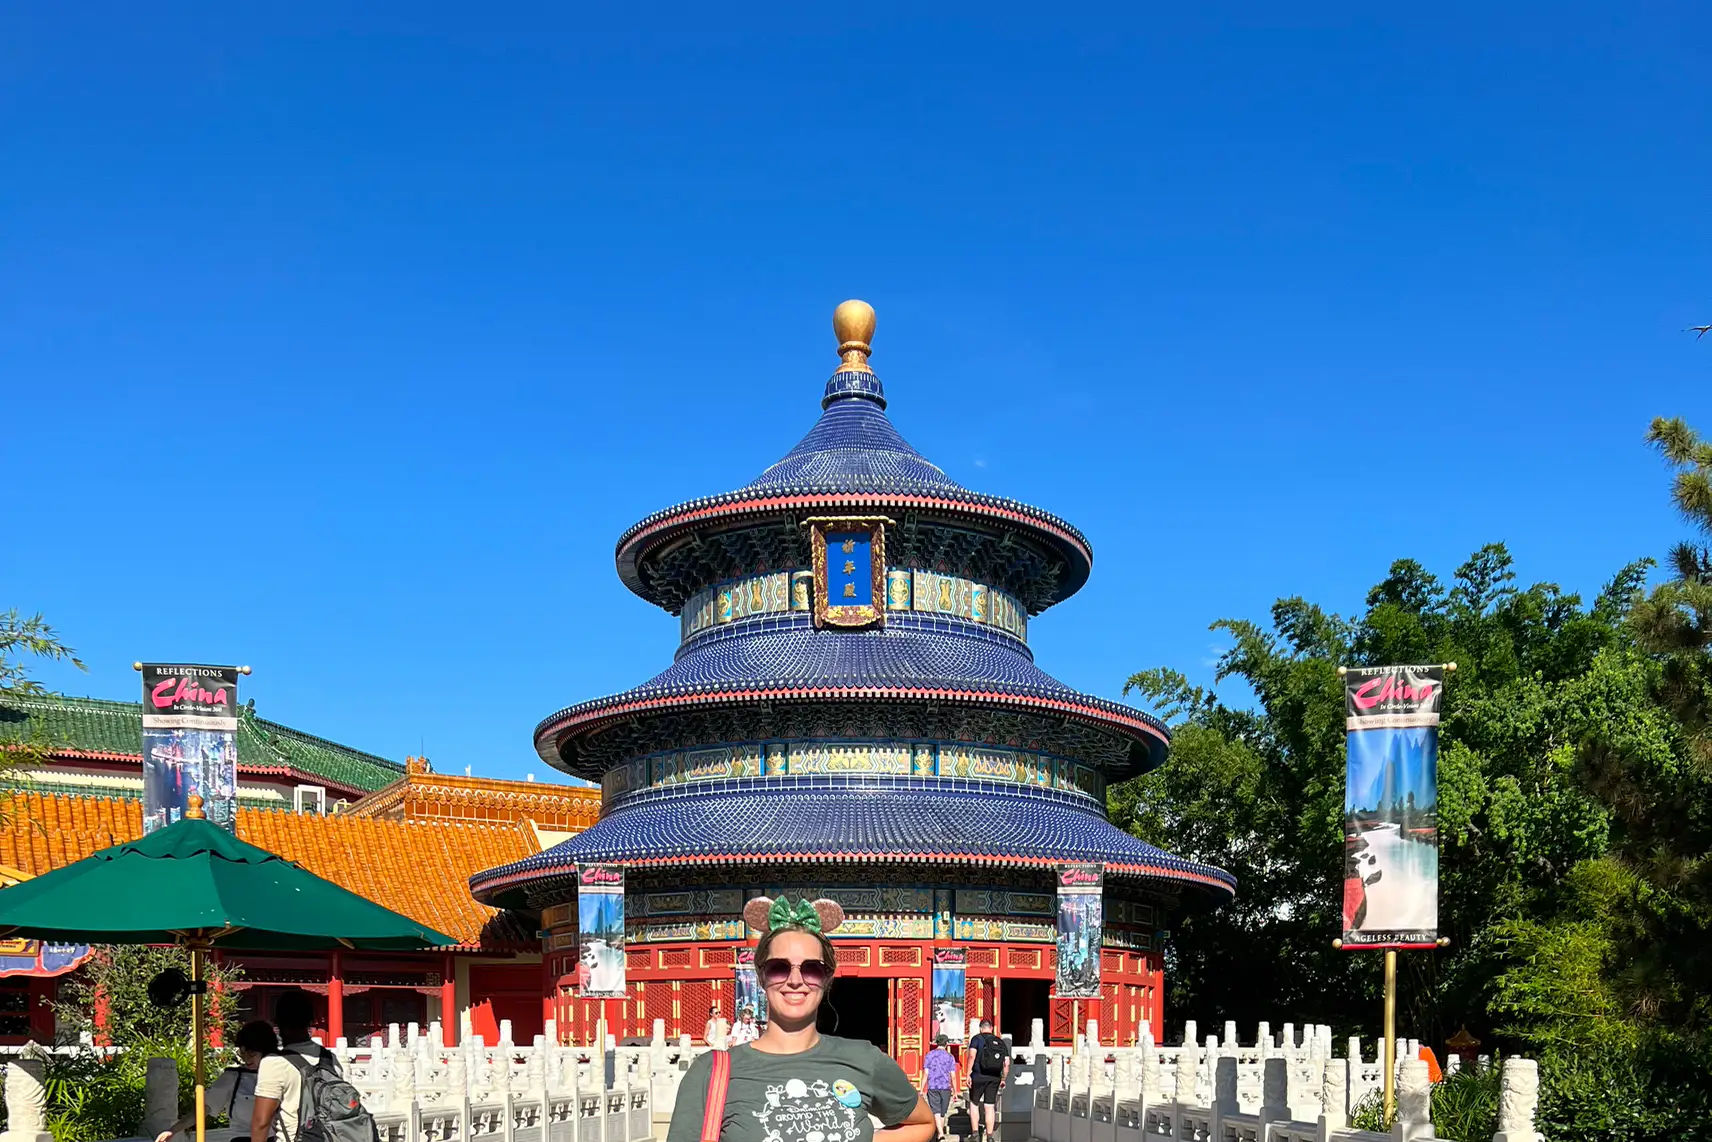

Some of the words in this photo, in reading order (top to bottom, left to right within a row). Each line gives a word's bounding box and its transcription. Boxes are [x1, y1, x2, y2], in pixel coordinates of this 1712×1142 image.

[156, 667, 223, 677] REFLECTIONS
[1361, 665, 1430, 676] REFLECTIONS
[151, 677, 228, 708] China
[1353, 675, 1433, 709] China
[581, 867, 620, 884] China
[1061, 868, 1099, 885] China
[1354, 933, 1391, 942] AGELESS
[1393, 933, 1427, 942] BEAUTY
